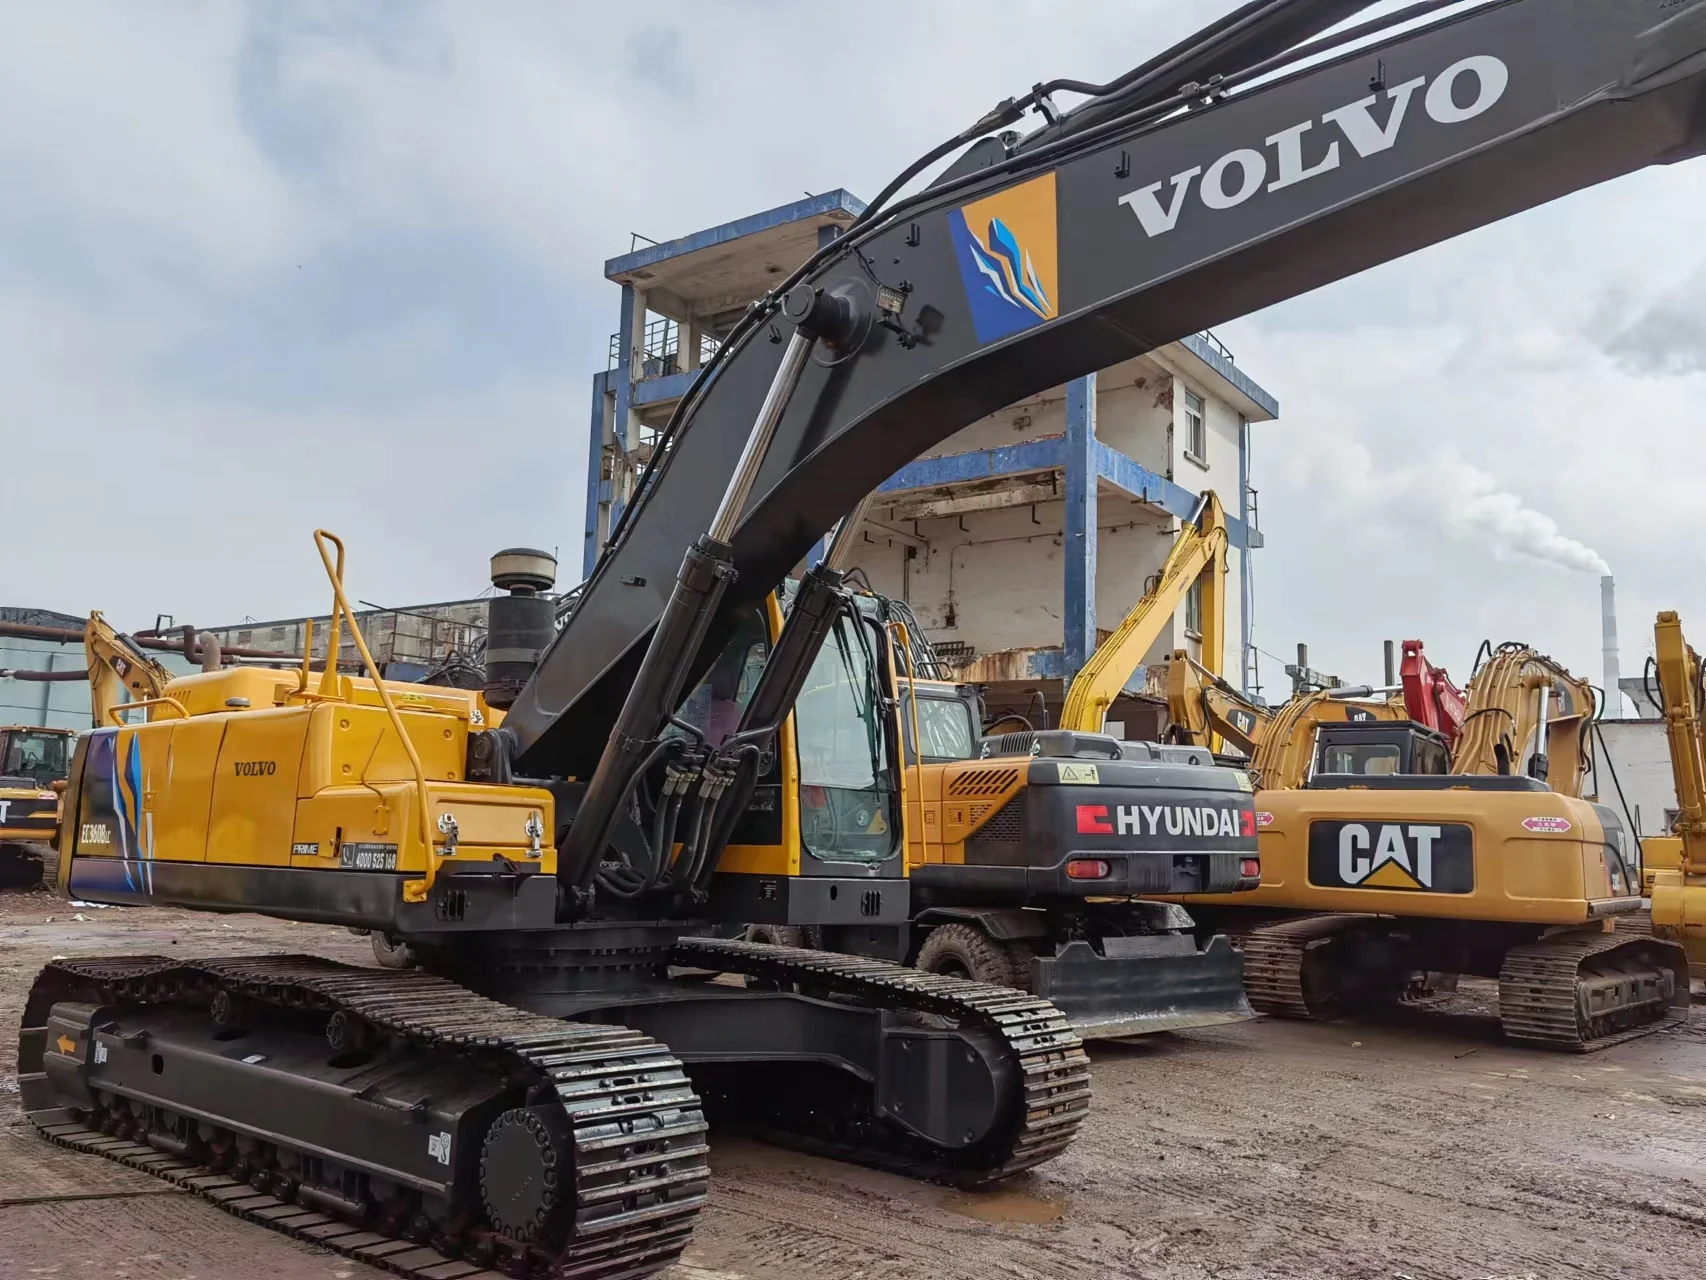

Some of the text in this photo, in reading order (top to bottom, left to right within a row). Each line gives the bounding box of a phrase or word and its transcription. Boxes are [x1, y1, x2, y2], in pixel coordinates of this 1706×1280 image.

[1118, 54, 1509, 238] VOLVO
[1237, 711, 1249, 734] CAT
[234, 760, 276, 776] VOLVO
[1116, 805, 1240, 837] HYUNDAI
[292, 844, 318, 855] PRIME
[356, 852, 396, 870] 4000 525 168
[1338, 823, 1441, 888] CAT
